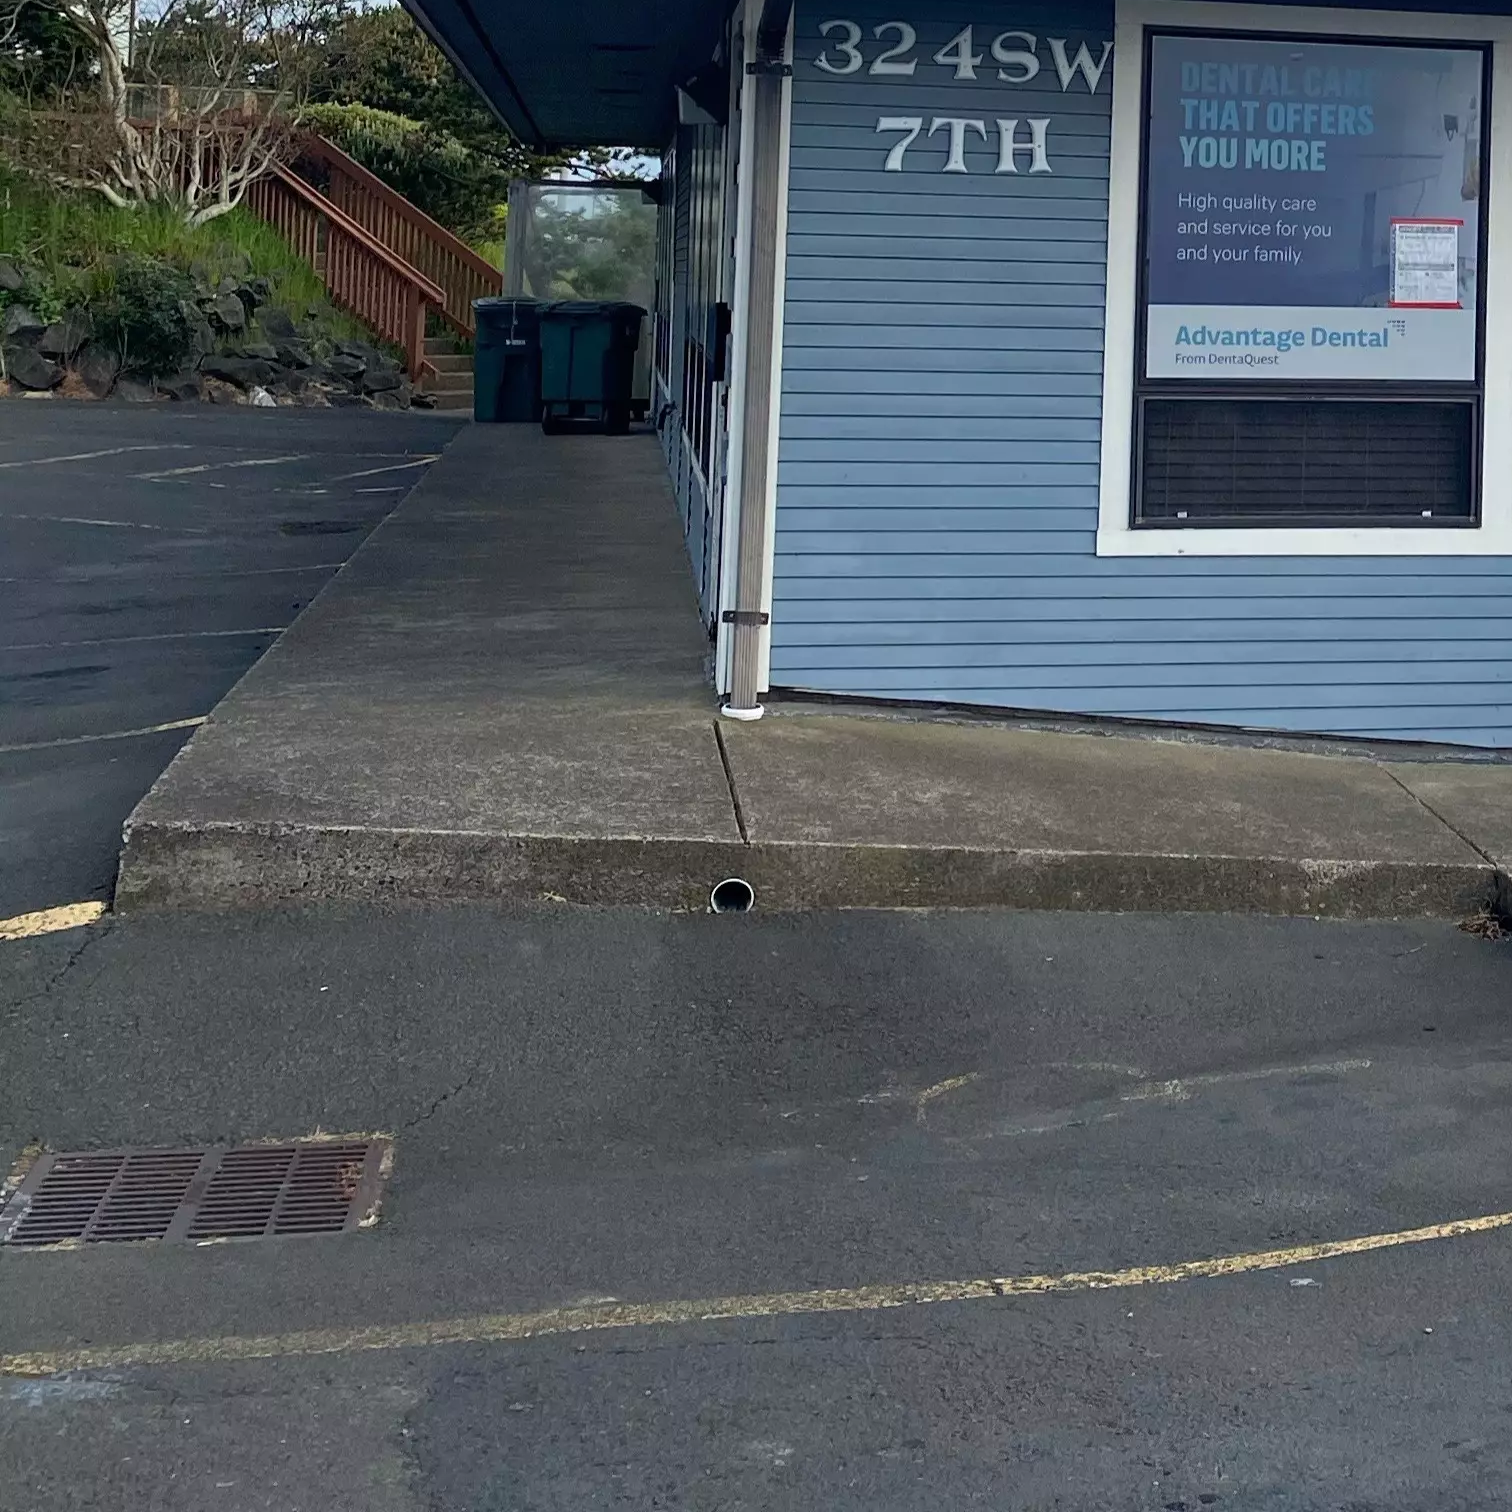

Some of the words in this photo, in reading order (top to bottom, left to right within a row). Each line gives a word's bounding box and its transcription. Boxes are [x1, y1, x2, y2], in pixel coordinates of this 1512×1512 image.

[1181, 61, 1295, 96] DENTAL
[1180, 98, 1260, 132] THAT
[1266, 101, 1375, 136] OFFERS
[875, 116, 1053, 174] 7TH
[1179, 136, 1239, 169] YOU
[1244, 138, 1327, 172] MORE
[1177, 192, 1218, 213] High
[1222, 194, 1277, 215] quality
[1281, 198, 1317, 212] care
[1177, 218, 1208, 236] and
[1213, 220, 1271, 236] service
[1276, 219, 1298, 237] for
[1302, 224, 1332, 240] you
[1176, 244, 1208, 261] and
[1212, 247, 1250, 265] your
[1175, 325, 1305, 353] Advantage
[1311, 327, 1389, 348] Dental
[1175, 353, 1206, 366] From
[1208, 353, 1280, 368] DentaQuest
